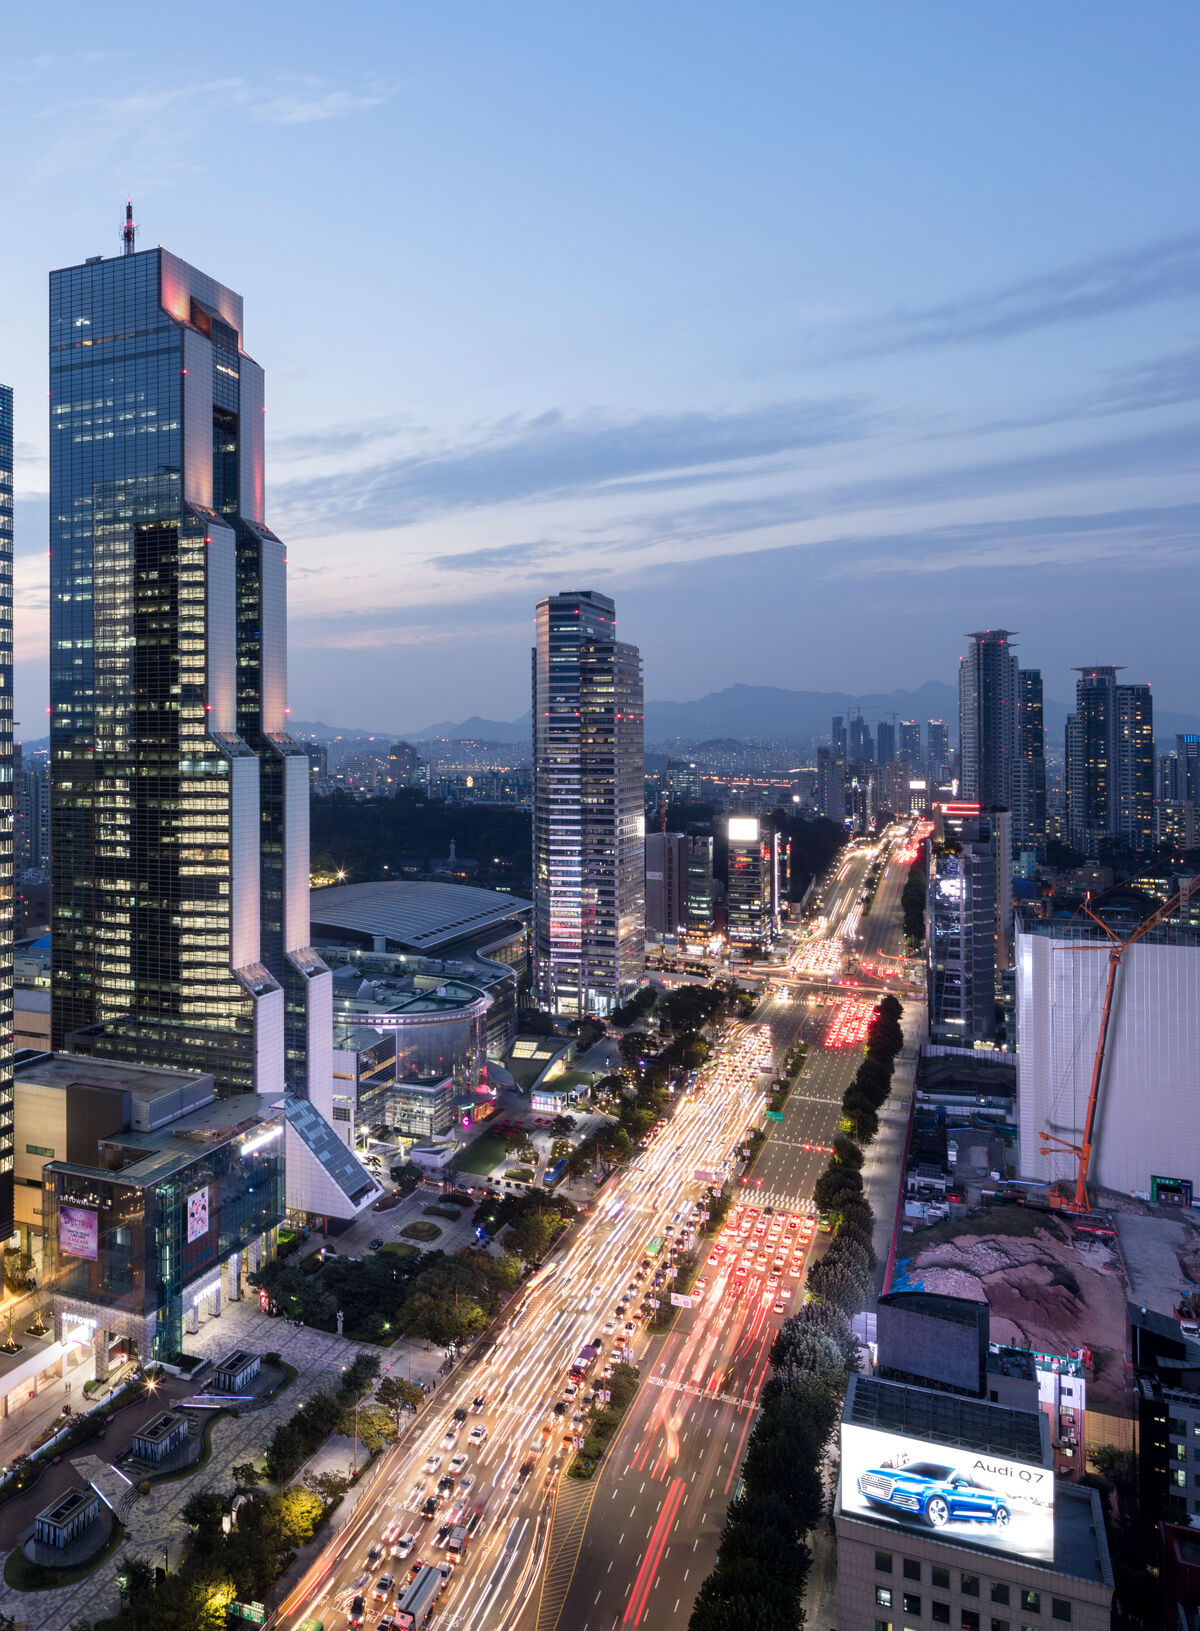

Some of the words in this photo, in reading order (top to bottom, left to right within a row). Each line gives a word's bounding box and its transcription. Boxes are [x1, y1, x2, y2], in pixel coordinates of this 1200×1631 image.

[61, 1312, 97, 1329] SMTOWN
[973, 1459, 1013, 1477] Audi
[1018, 1470, 1044, 1484] Q7
